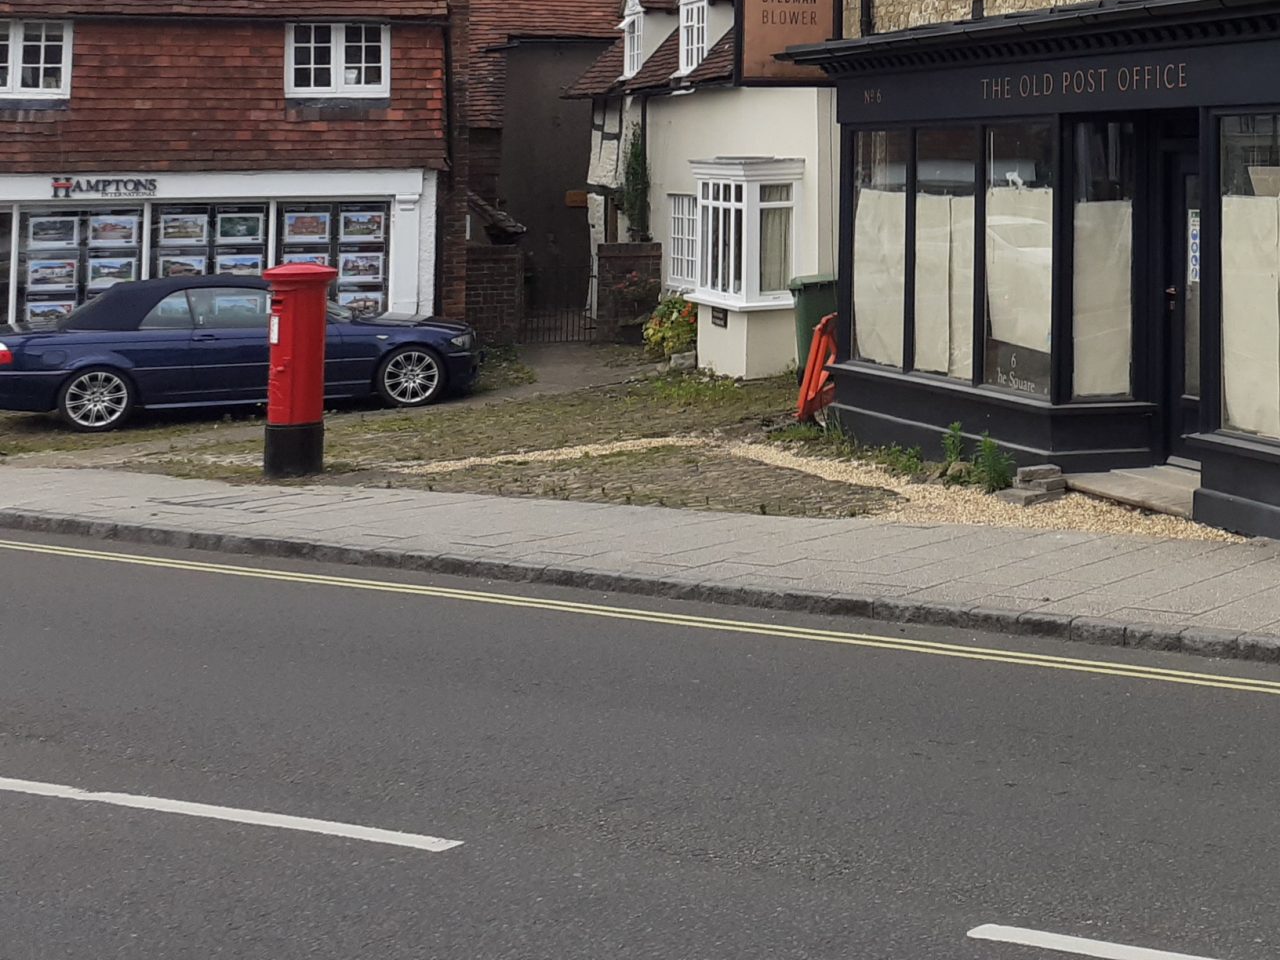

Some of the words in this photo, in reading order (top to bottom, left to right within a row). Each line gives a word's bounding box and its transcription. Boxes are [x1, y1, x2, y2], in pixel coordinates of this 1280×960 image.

[762, 9, 817, 25] BLOWER
[981, 76, 1012, 100] THE
[1019, 73, 1054, 97] OLD
[1062, 68, 1108, 94] POST
[1117, 63, 1187, 91] OFFICE
[876, 88, 882, 104] 6
[51, 177, 157, 198] HAMPTONS
[1010, 352, 1017, 368] 6
[1009, 371, 1035, 392] Square
